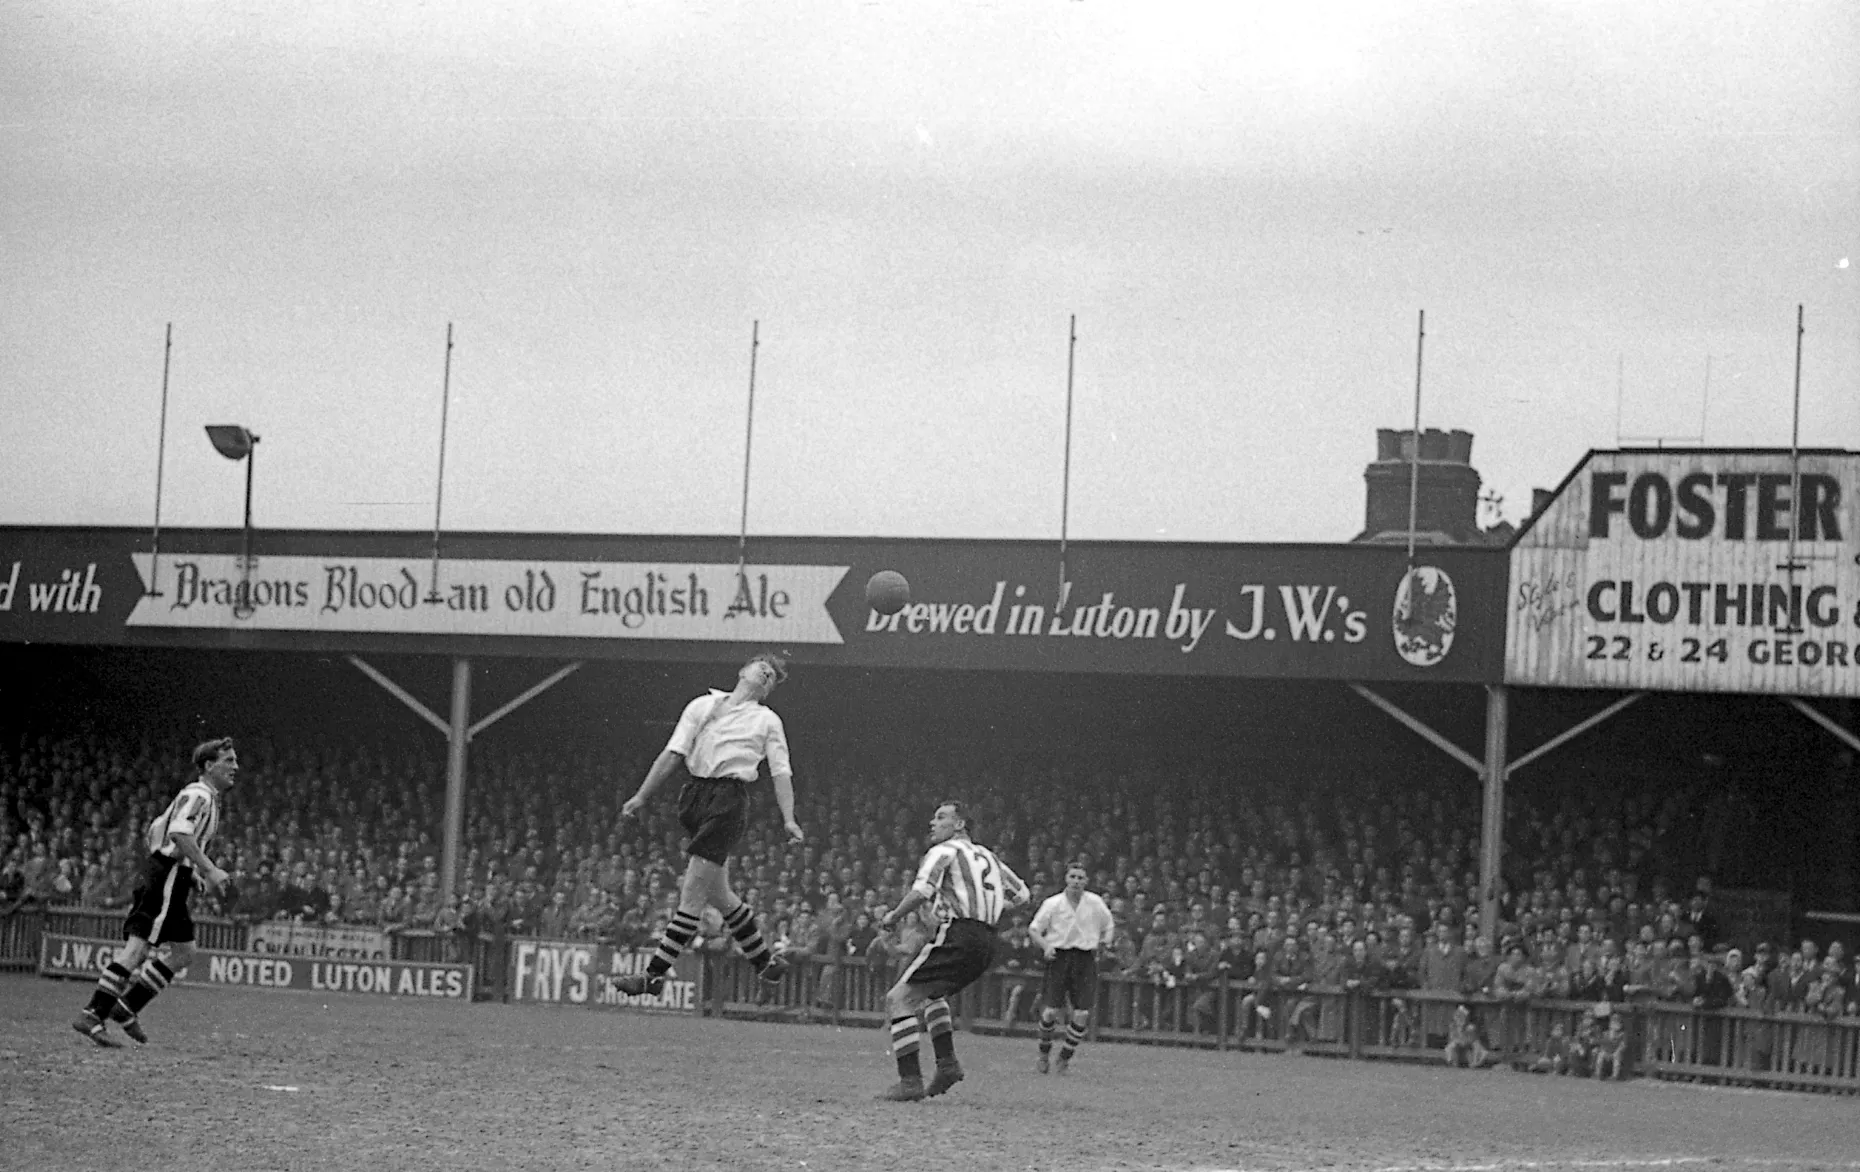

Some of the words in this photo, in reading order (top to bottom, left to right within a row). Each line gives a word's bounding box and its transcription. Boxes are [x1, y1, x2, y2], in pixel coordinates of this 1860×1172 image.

[1589, 471, 1843, 541] FOSTER
[29, 562, 101, 614] with
[169, 561, 309, 620] Dragons
[320, 564, 418, 615] Blood
[505, 569, 557, 613] old
[580, 570, 709, 629] English
[723, 571, 792, 620] Ale
[1586, 580, 1840, 629] CLOTHING
[1005, 584, 1045, 636] in
[1048, 581, 1160, 638] Luton
[1164, 583, 1217, 653] by
[1586, 635, 1632, 661] 22
[1648, 643, 1664, 662] &
[1680, 638, 1729, 664] 24
[1748, 639, 1860, 667] GEOR
[974, 852, 995, 891] 2
[209, 956, 293, 987] NOTED
[311, 963, 391, 993] LUTON
[398, 968, 463, 997] ALES
[611, 952, 656, 975] MIL
